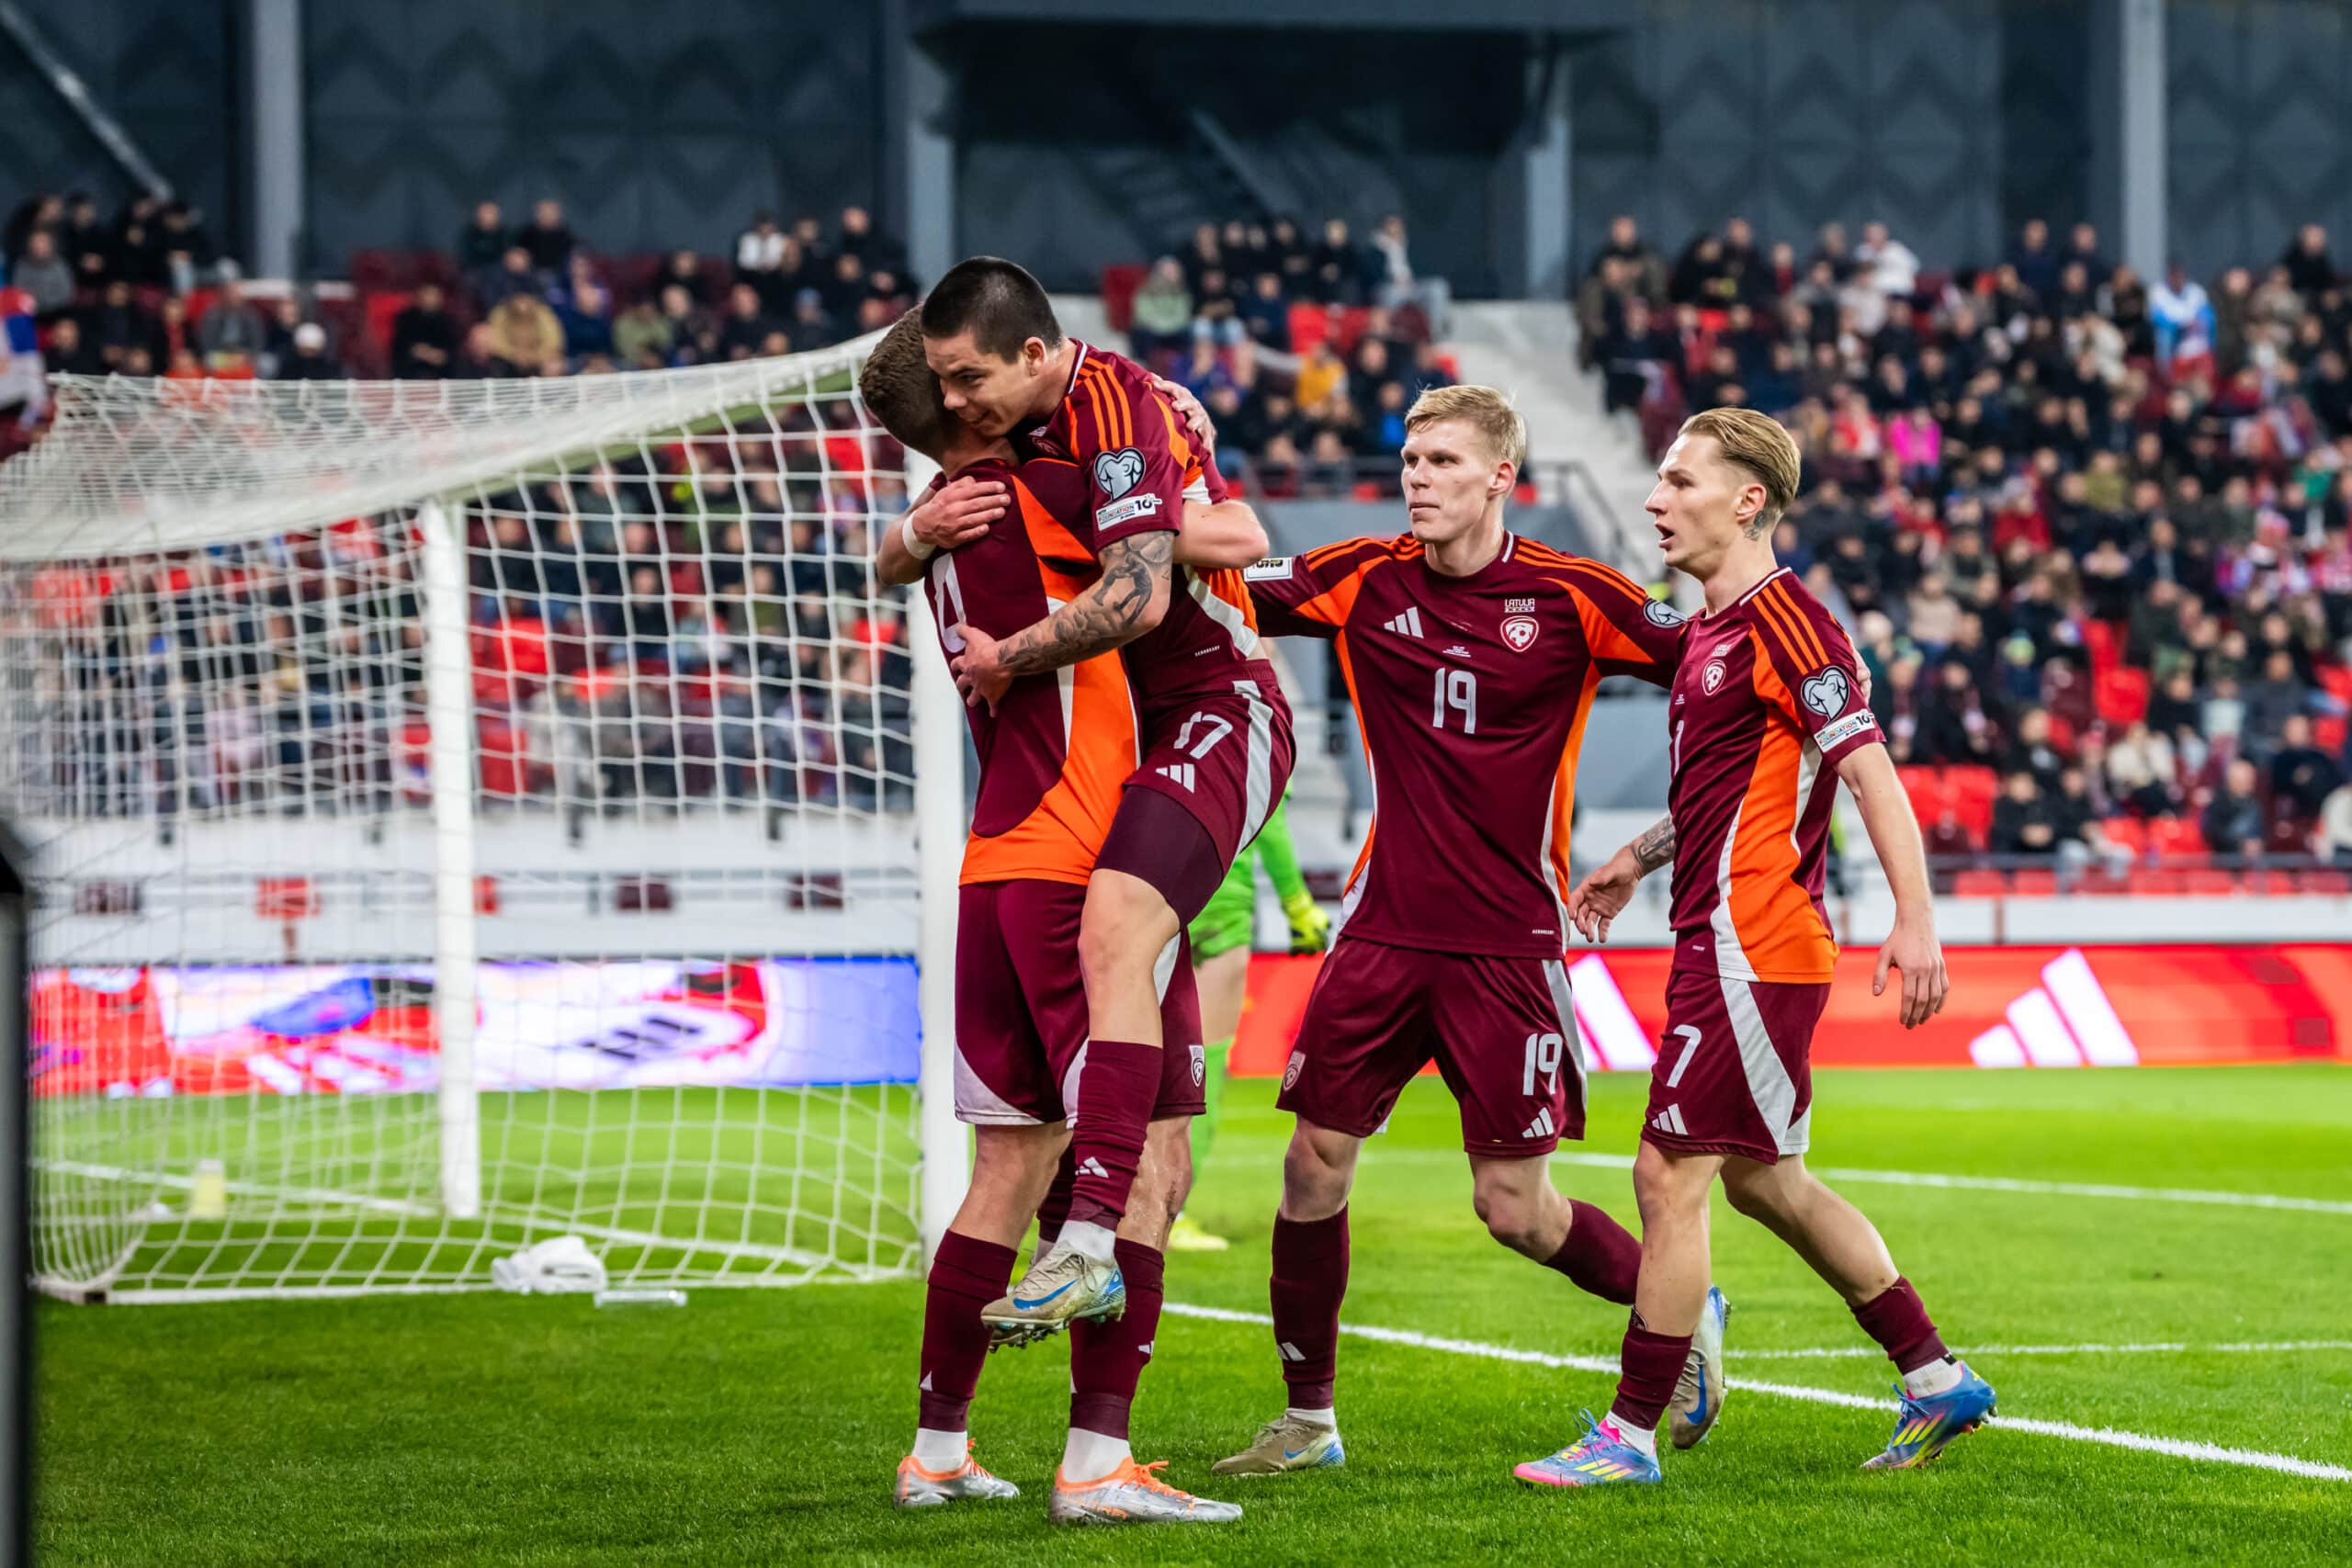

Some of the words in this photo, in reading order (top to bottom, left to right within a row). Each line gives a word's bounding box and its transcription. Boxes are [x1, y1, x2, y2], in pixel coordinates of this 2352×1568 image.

[1433, 667, 1477, 734] 19
[1173, 711, 1233, 760] 17
[1522, 1032, 1564, 1096] 19
[1667, 1023, 1702, 1089] 7
